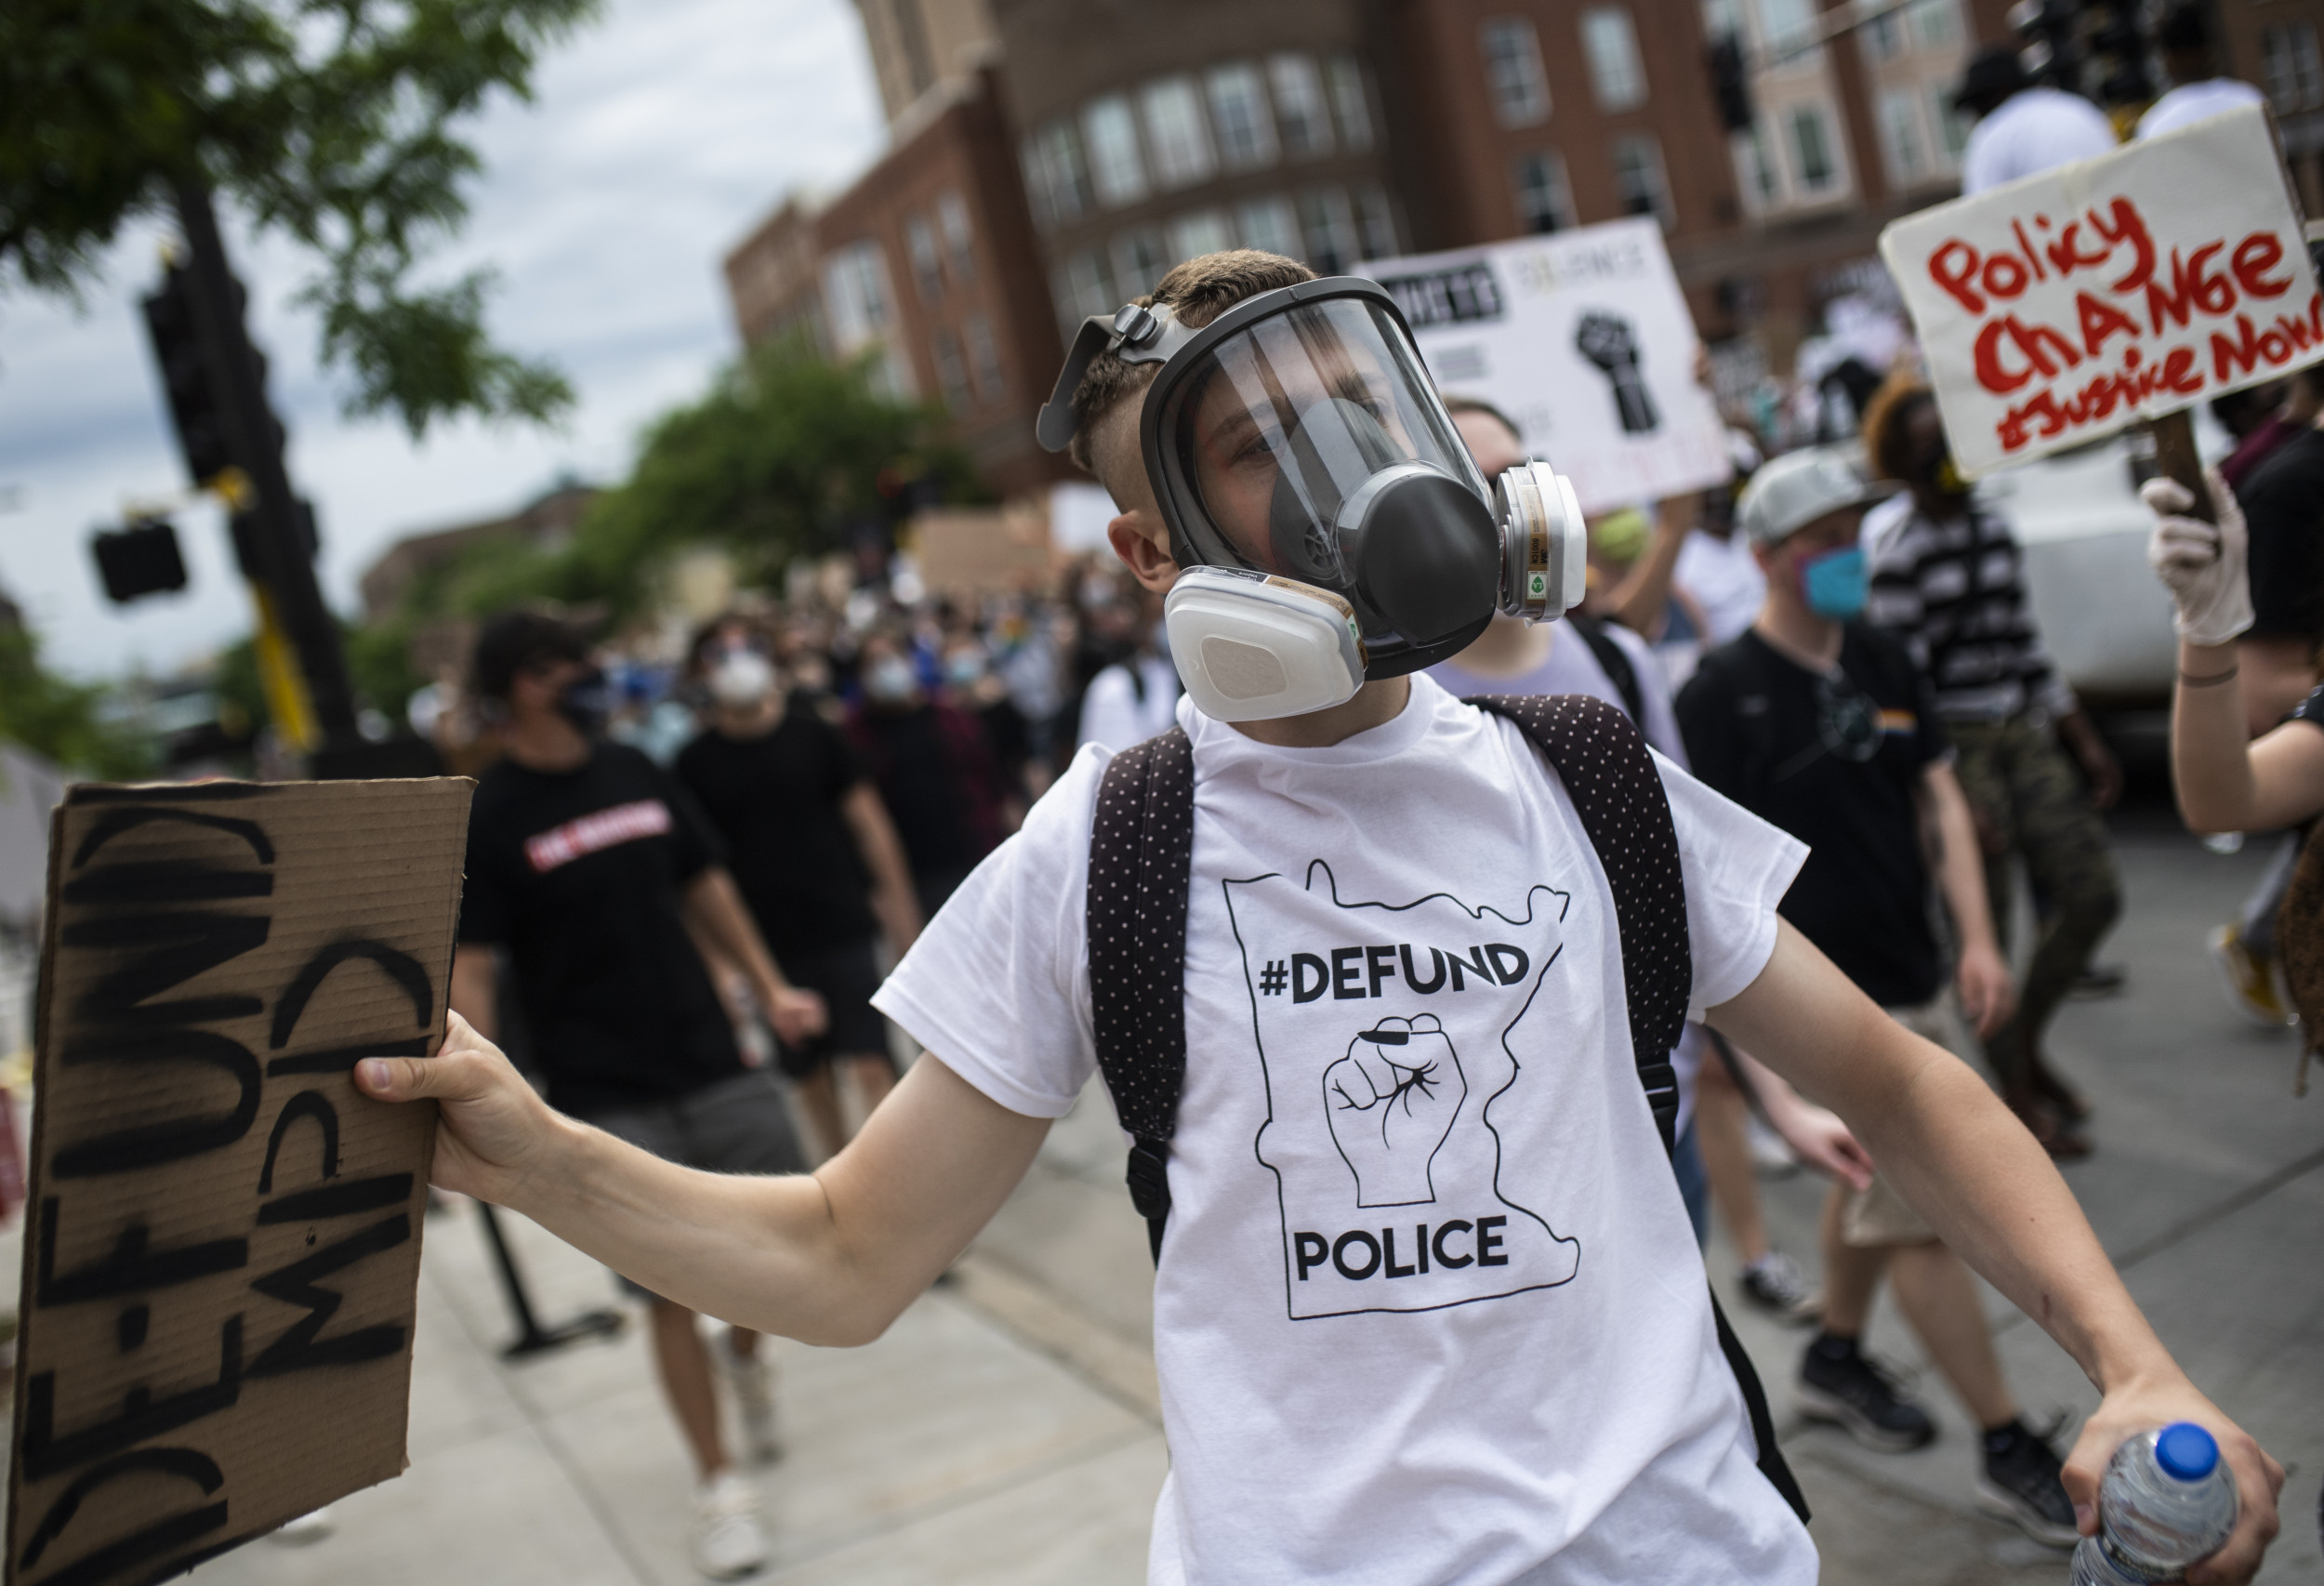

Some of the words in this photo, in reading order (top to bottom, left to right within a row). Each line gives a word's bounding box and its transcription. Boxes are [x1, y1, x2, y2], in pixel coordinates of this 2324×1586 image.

[1259, 943, 1530, 1005] #DEFUND
[244, 939, 433, 1380] MPD
[1293, 1215, 1509, 1281] POLICE
